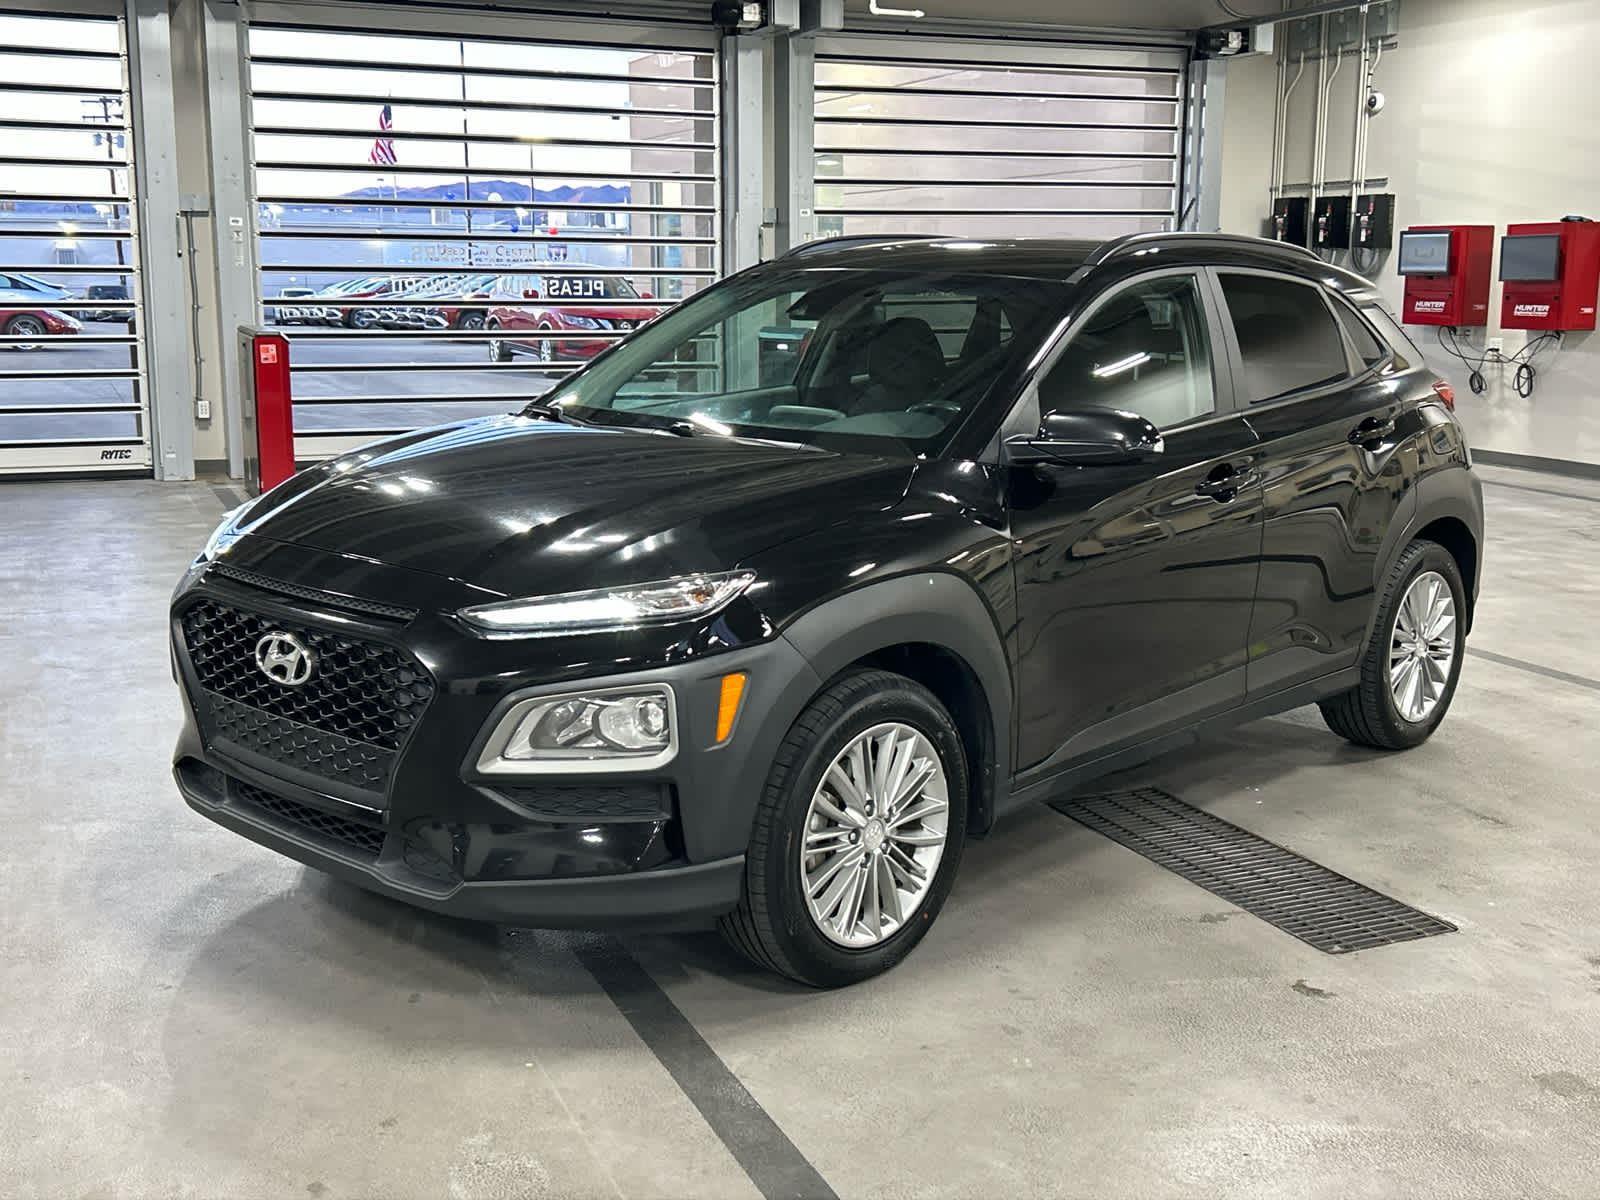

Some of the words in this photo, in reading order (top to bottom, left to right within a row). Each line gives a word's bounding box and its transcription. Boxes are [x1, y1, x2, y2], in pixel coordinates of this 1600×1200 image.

[1415, 301, 1446, 309] HUNTER
[1514, 304, 1550, 313] HUNTER
[101, 449, 132, 460] RYTEC
